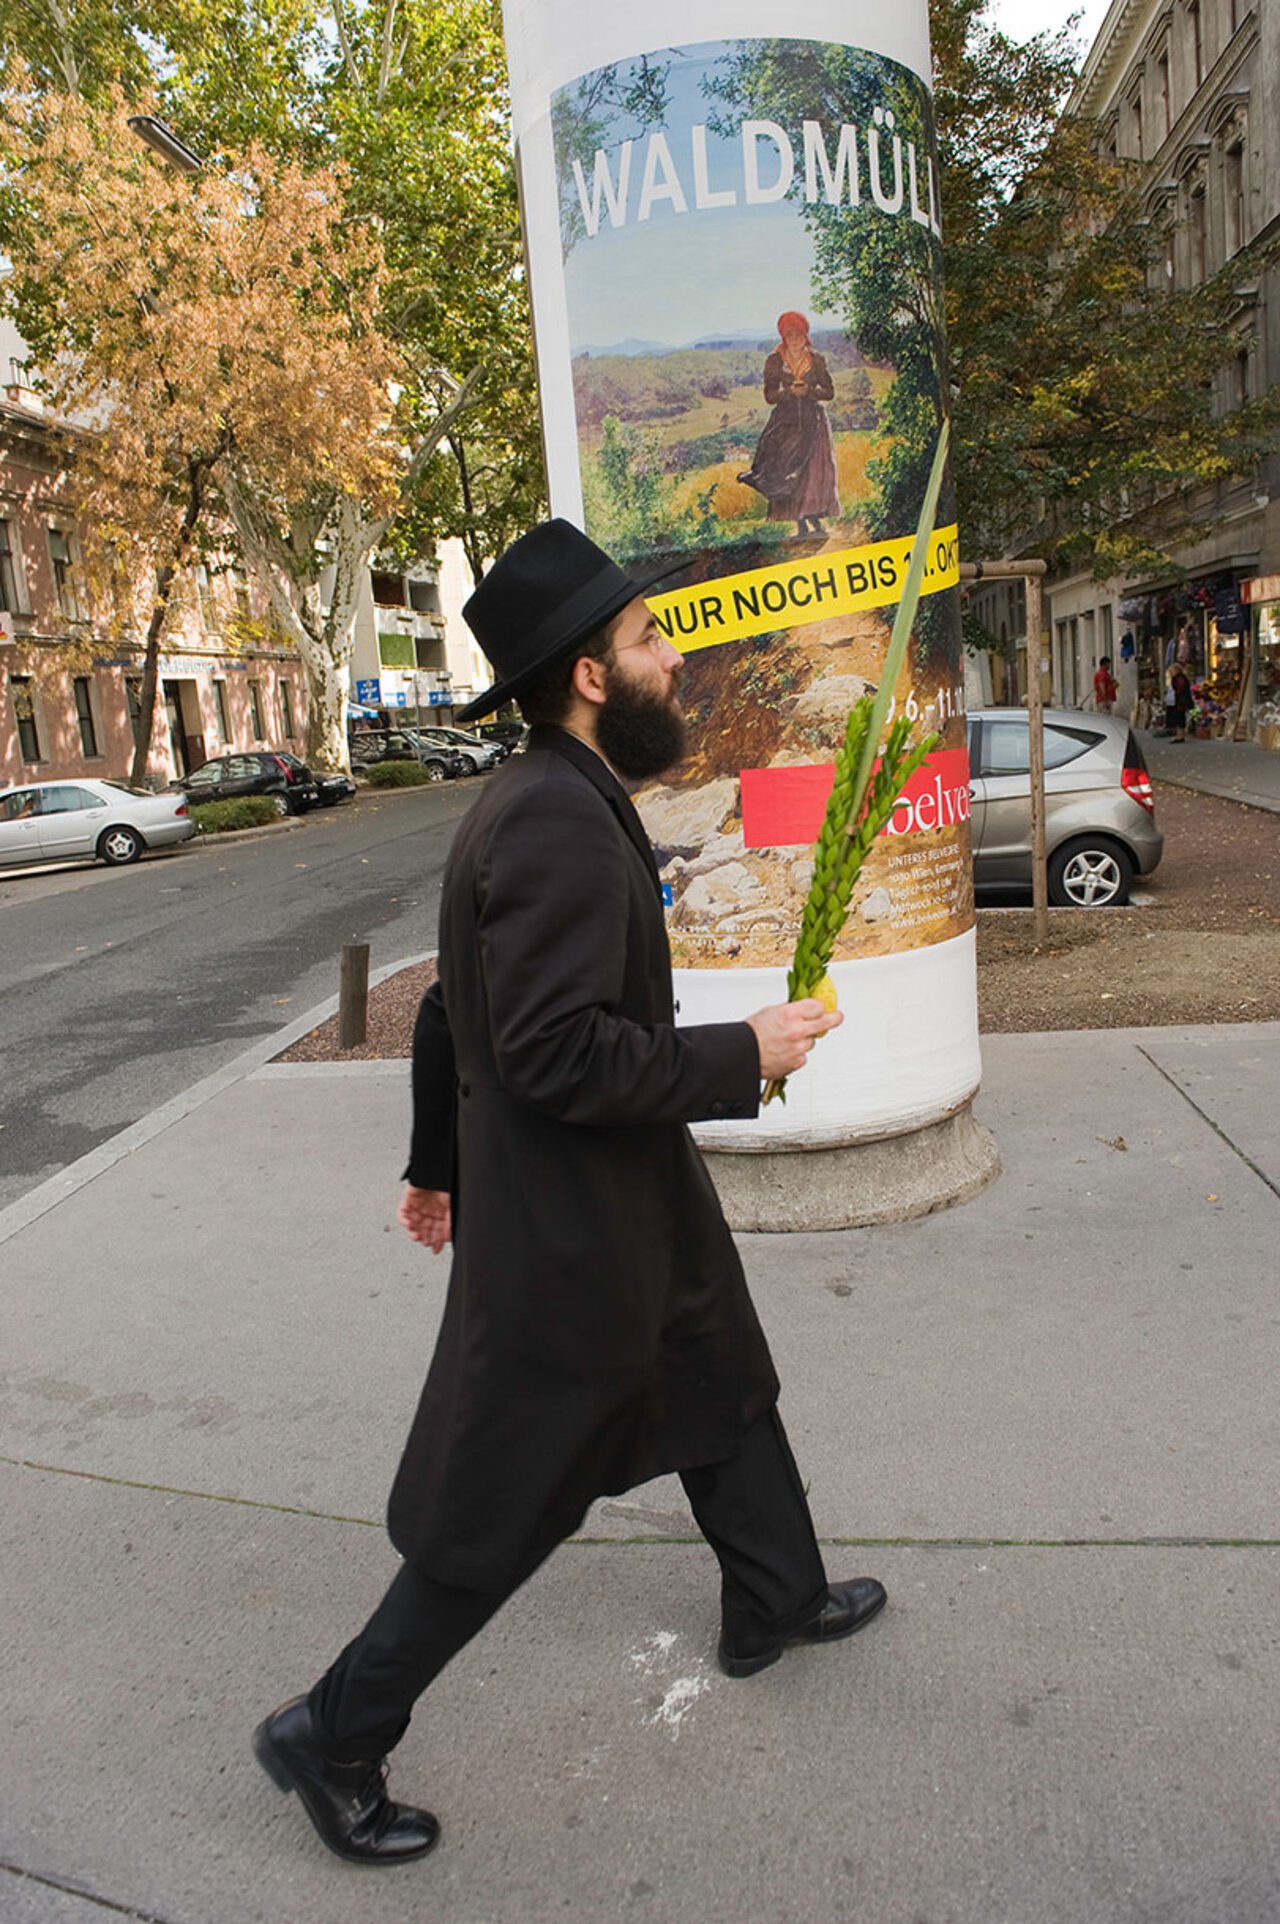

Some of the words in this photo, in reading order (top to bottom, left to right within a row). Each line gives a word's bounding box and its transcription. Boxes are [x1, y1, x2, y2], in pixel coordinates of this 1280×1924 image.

[652, 596, 726, 638] NUR
[732, 568, 838, 620] NOCH
[846, 555, 897, 594] BIS
[888, 850, 927, 867] UNTERES
